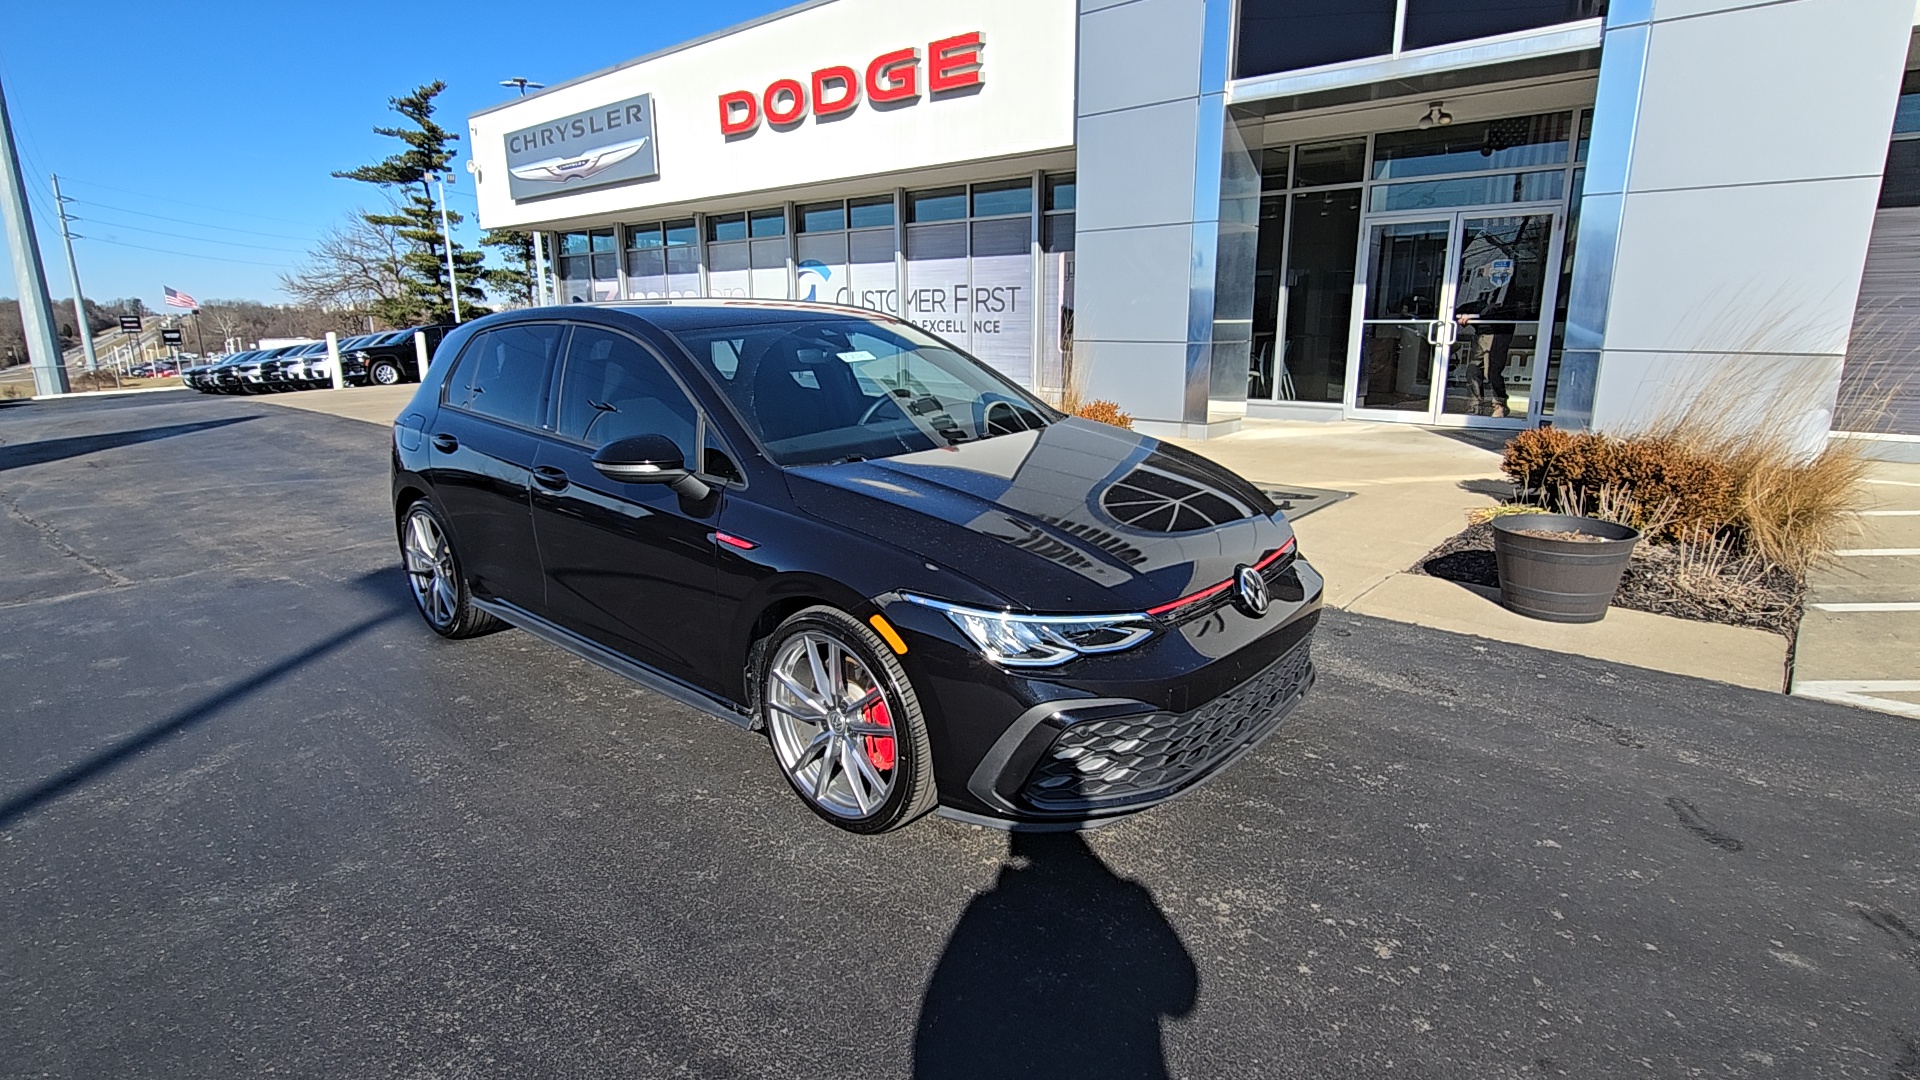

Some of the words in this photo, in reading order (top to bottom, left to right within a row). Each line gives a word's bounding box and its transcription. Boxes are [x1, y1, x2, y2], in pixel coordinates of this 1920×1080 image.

[719, 31, 986, 134] DODGE
[509, 103, 642, 153] CHRYSLER
[922, 320, 1000, 333] EXCELLNCE
